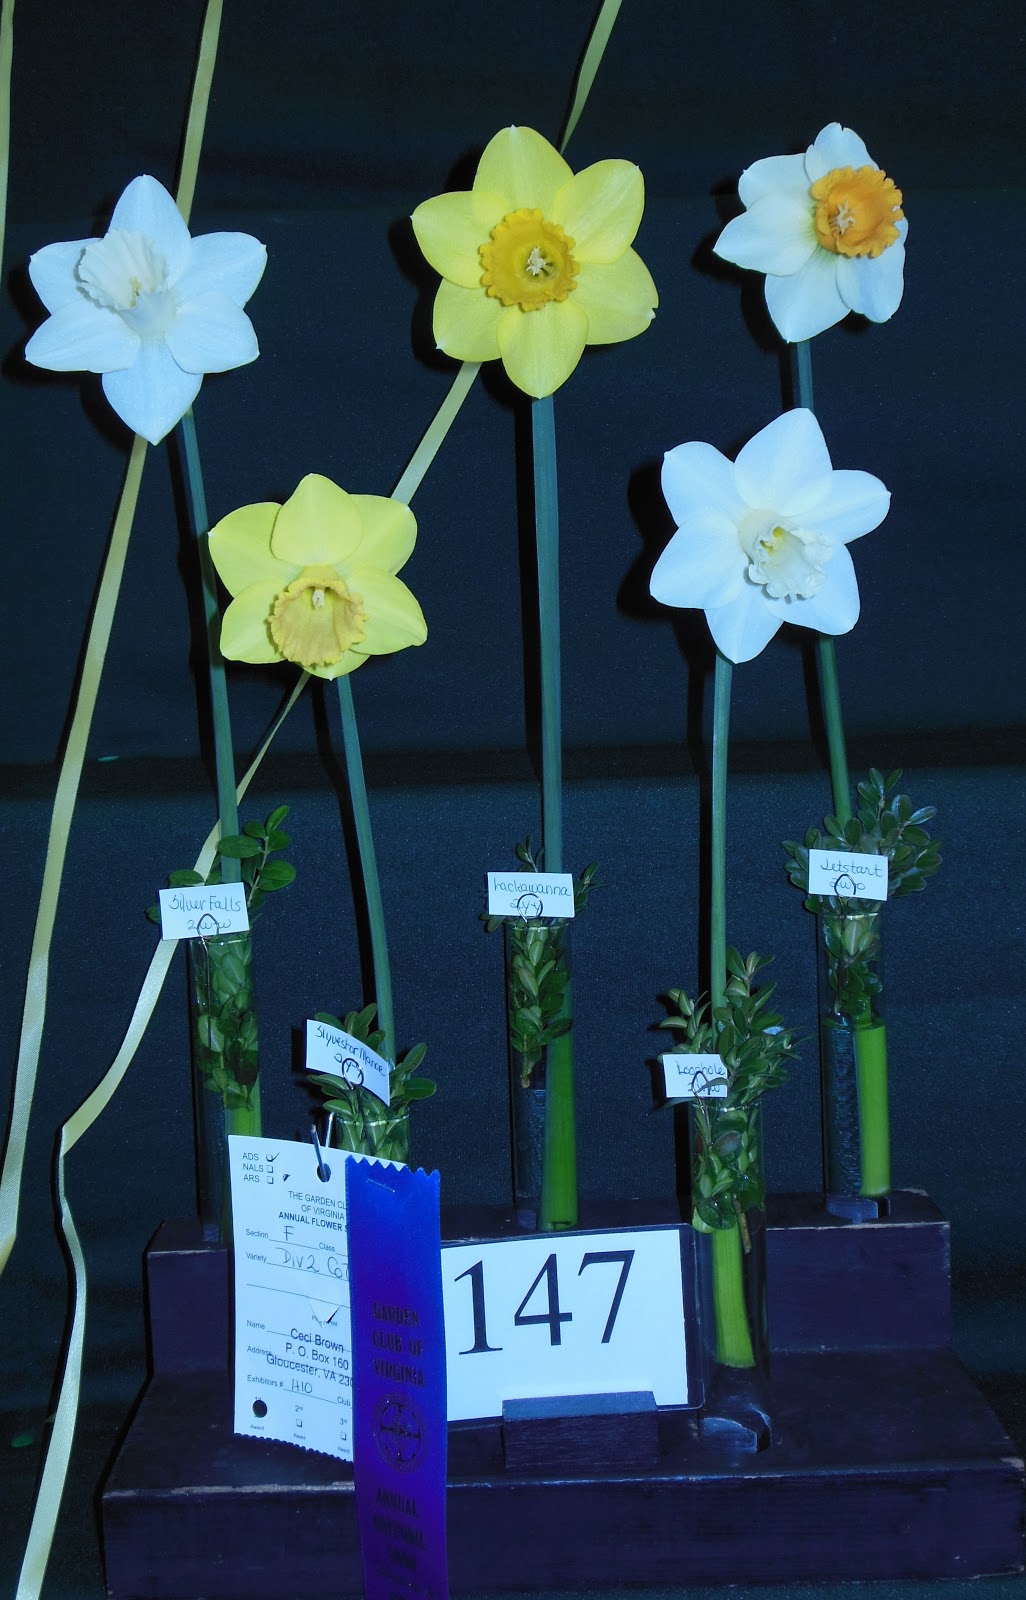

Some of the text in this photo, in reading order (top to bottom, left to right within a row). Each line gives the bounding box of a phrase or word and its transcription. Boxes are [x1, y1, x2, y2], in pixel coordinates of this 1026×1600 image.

[169, 892, 241, 912] Silver Falls
[242, 1152, 259, 1161] ADS
[242, 1163, 264, 1173] NALS
[243, 1174, 260, 1183] ARS
[288, 1190, 303, 1201] THE
[304, 1193, 336, 1208] GARDEN
[279, 1211, 310, 1225] ANNUAL
[311, 1217, 343, 1232] FLOWER
[301, 1204, 345, 1221] OF VIRGINIA
[245, 1225, 336, 1253] Section F Class
[246, 1251, 267, 1264] Variety
[454, 1250, 635, 1356] 147
[246, 1320, 344, 1353] Name Ceci Brown
[311, 1349, 330, 1365] Box
[333, 1356, 350, 1371] 160
[323, 1368, 337, 1382] VA
[374, 1357, 424, 1389] VIRGINIA
[336, 1396, 351, 1407] Club
